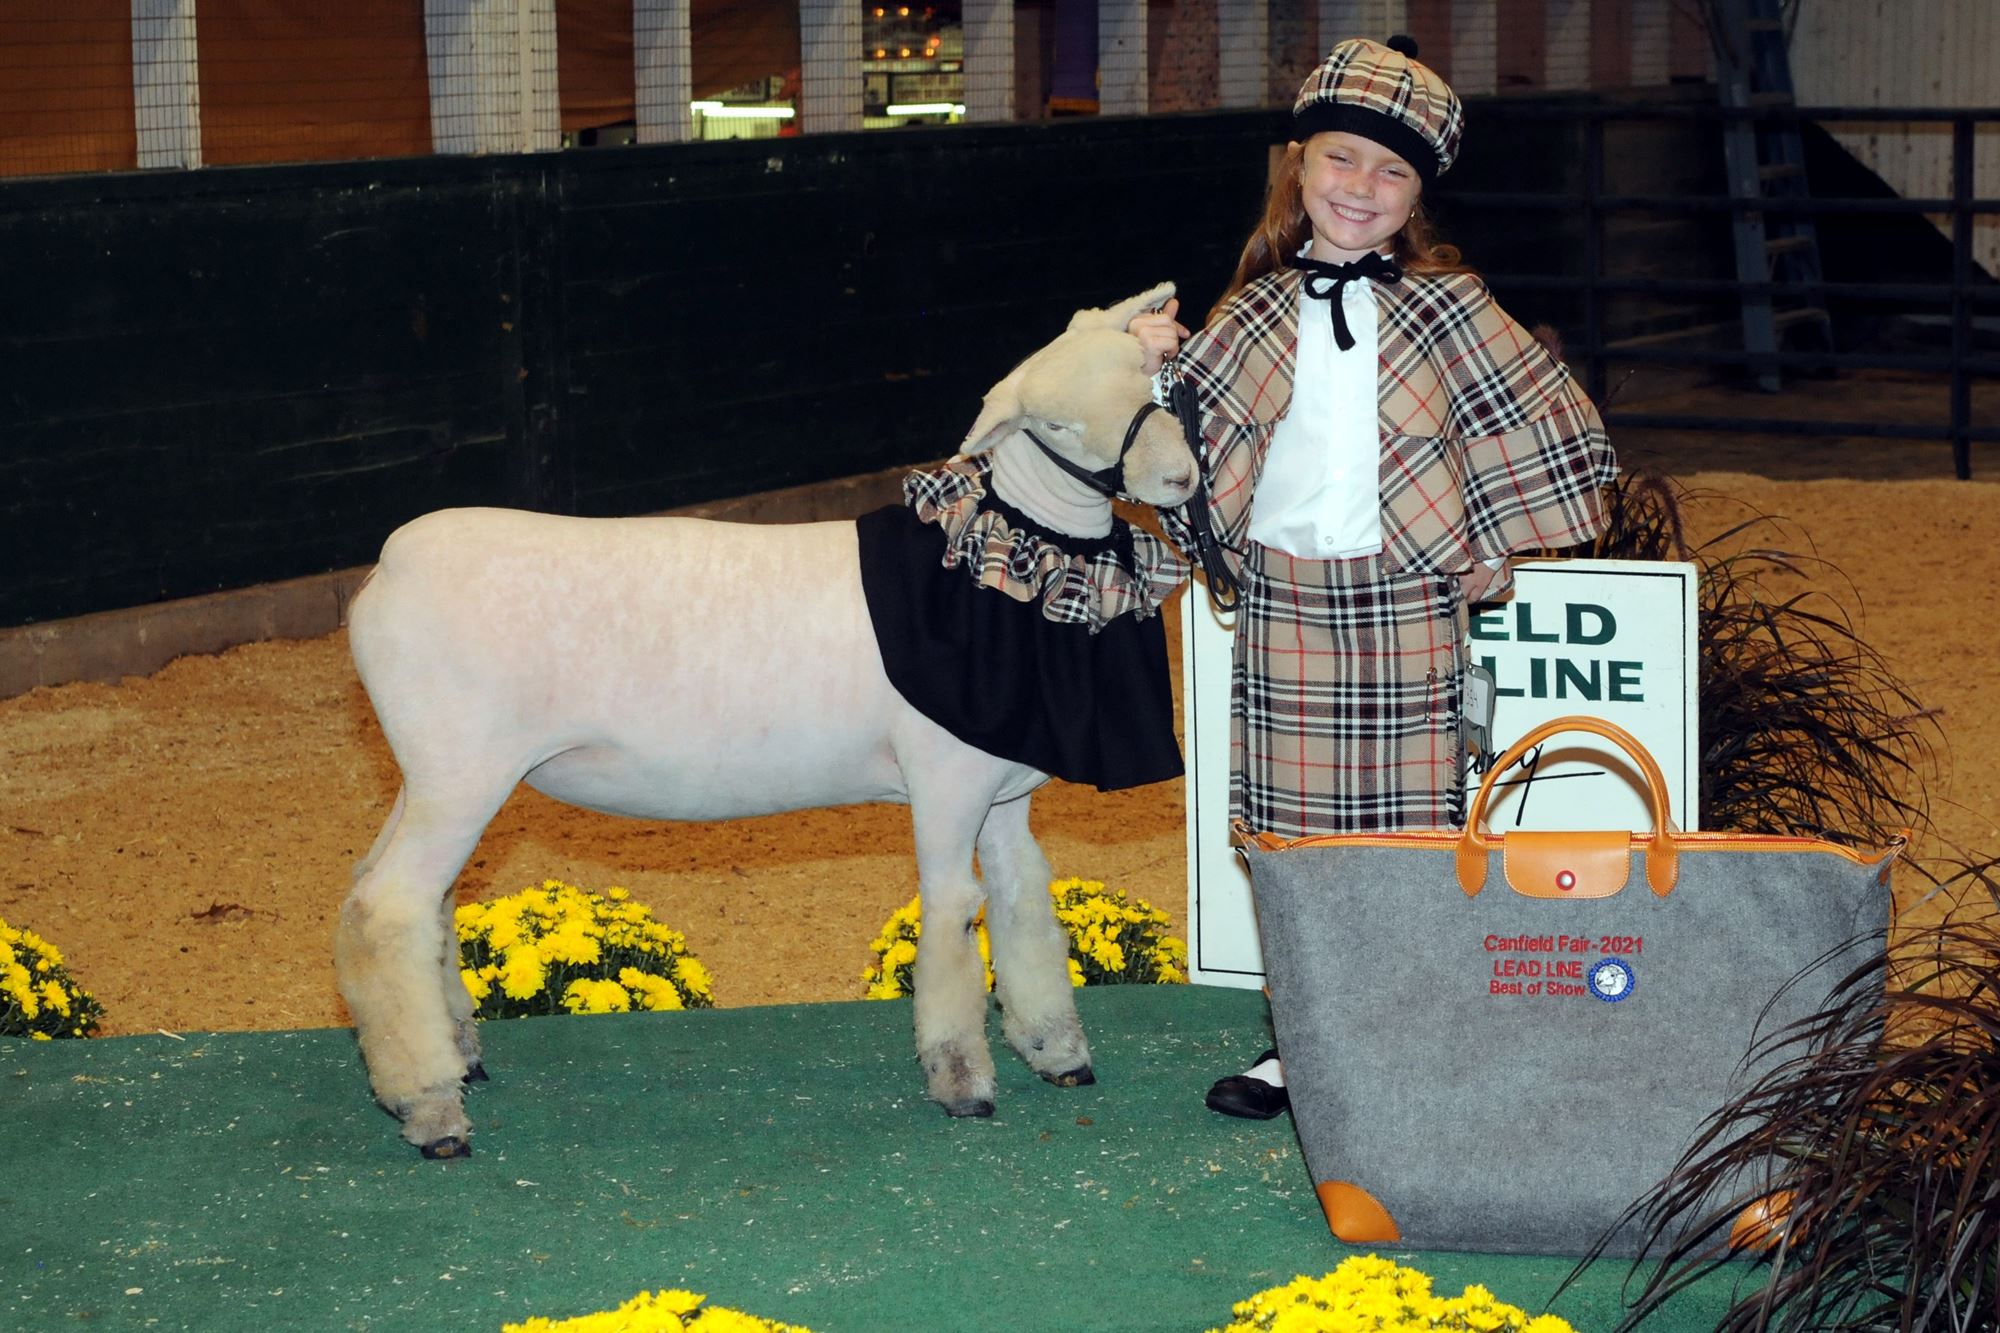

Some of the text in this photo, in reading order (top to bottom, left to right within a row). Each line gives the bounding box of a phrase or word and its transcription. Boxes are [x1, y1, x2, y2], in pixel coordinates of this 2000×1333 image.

[1481, 655, 1645, 703] LINE
[1483, 934, 1555, 953] Canfield
[1493, 959, 1584, 979] LEAD LINE
[1489, 979, 1586, 996] Best of Show
